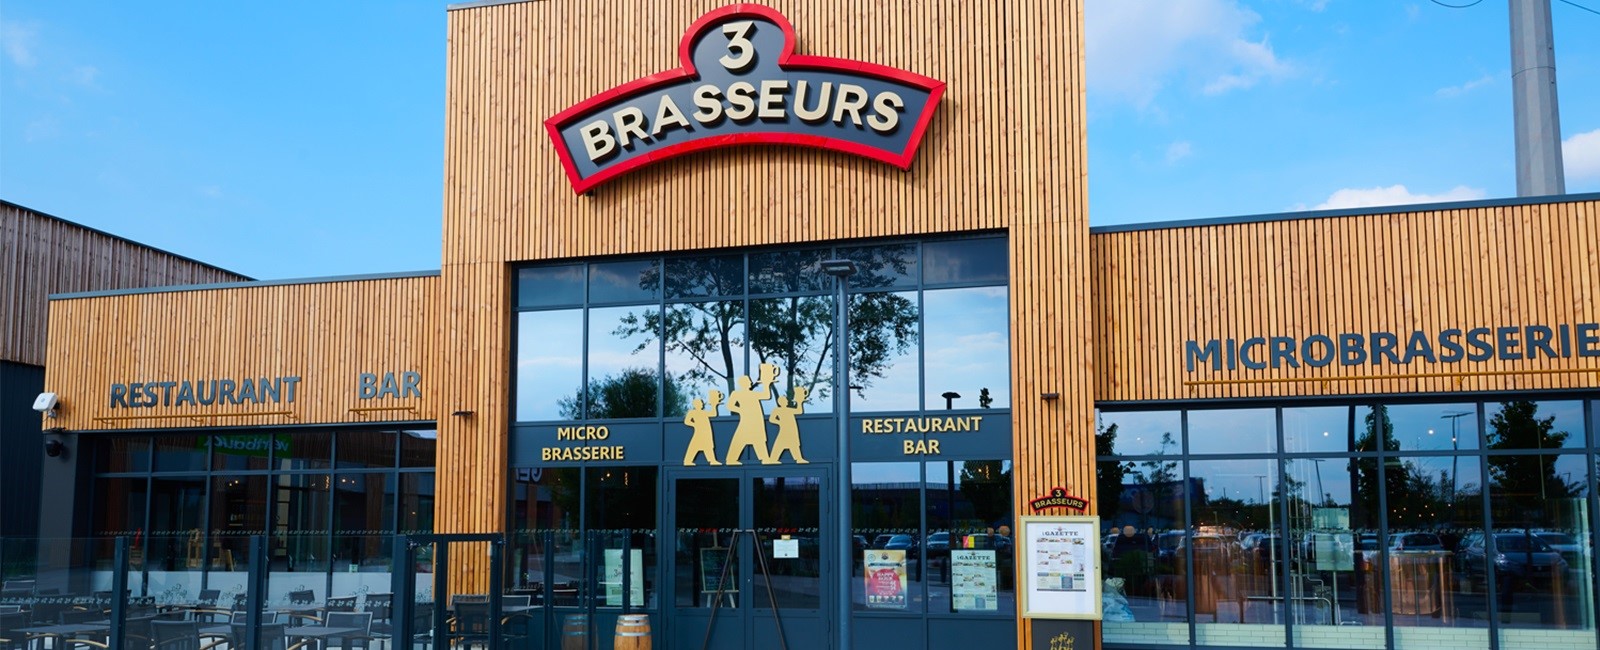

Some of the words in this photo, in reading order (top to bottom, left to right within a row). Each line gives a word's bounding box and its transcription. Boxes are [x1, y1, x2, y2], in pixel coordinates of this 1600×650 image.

[719, 20, 755, 69] 3
[579, 79, 905, 162] BRASSEURS
[1185, 322, 1600, 372] MICROBRASSERIE
[110, 376, 301, 408] RESTAURANT
[358, 371, 421, 399] BAR
[557, 425, 609, 440] MICRO
[862, 416, 983, 433] RESTAURANT
[541, 446, 624, 461] BRASSERIE
[903, 439, 941, 454] BAR
[1055, 489, 1062, 497] 3
[1034, 498, 1084, 509] BRASSEURS
